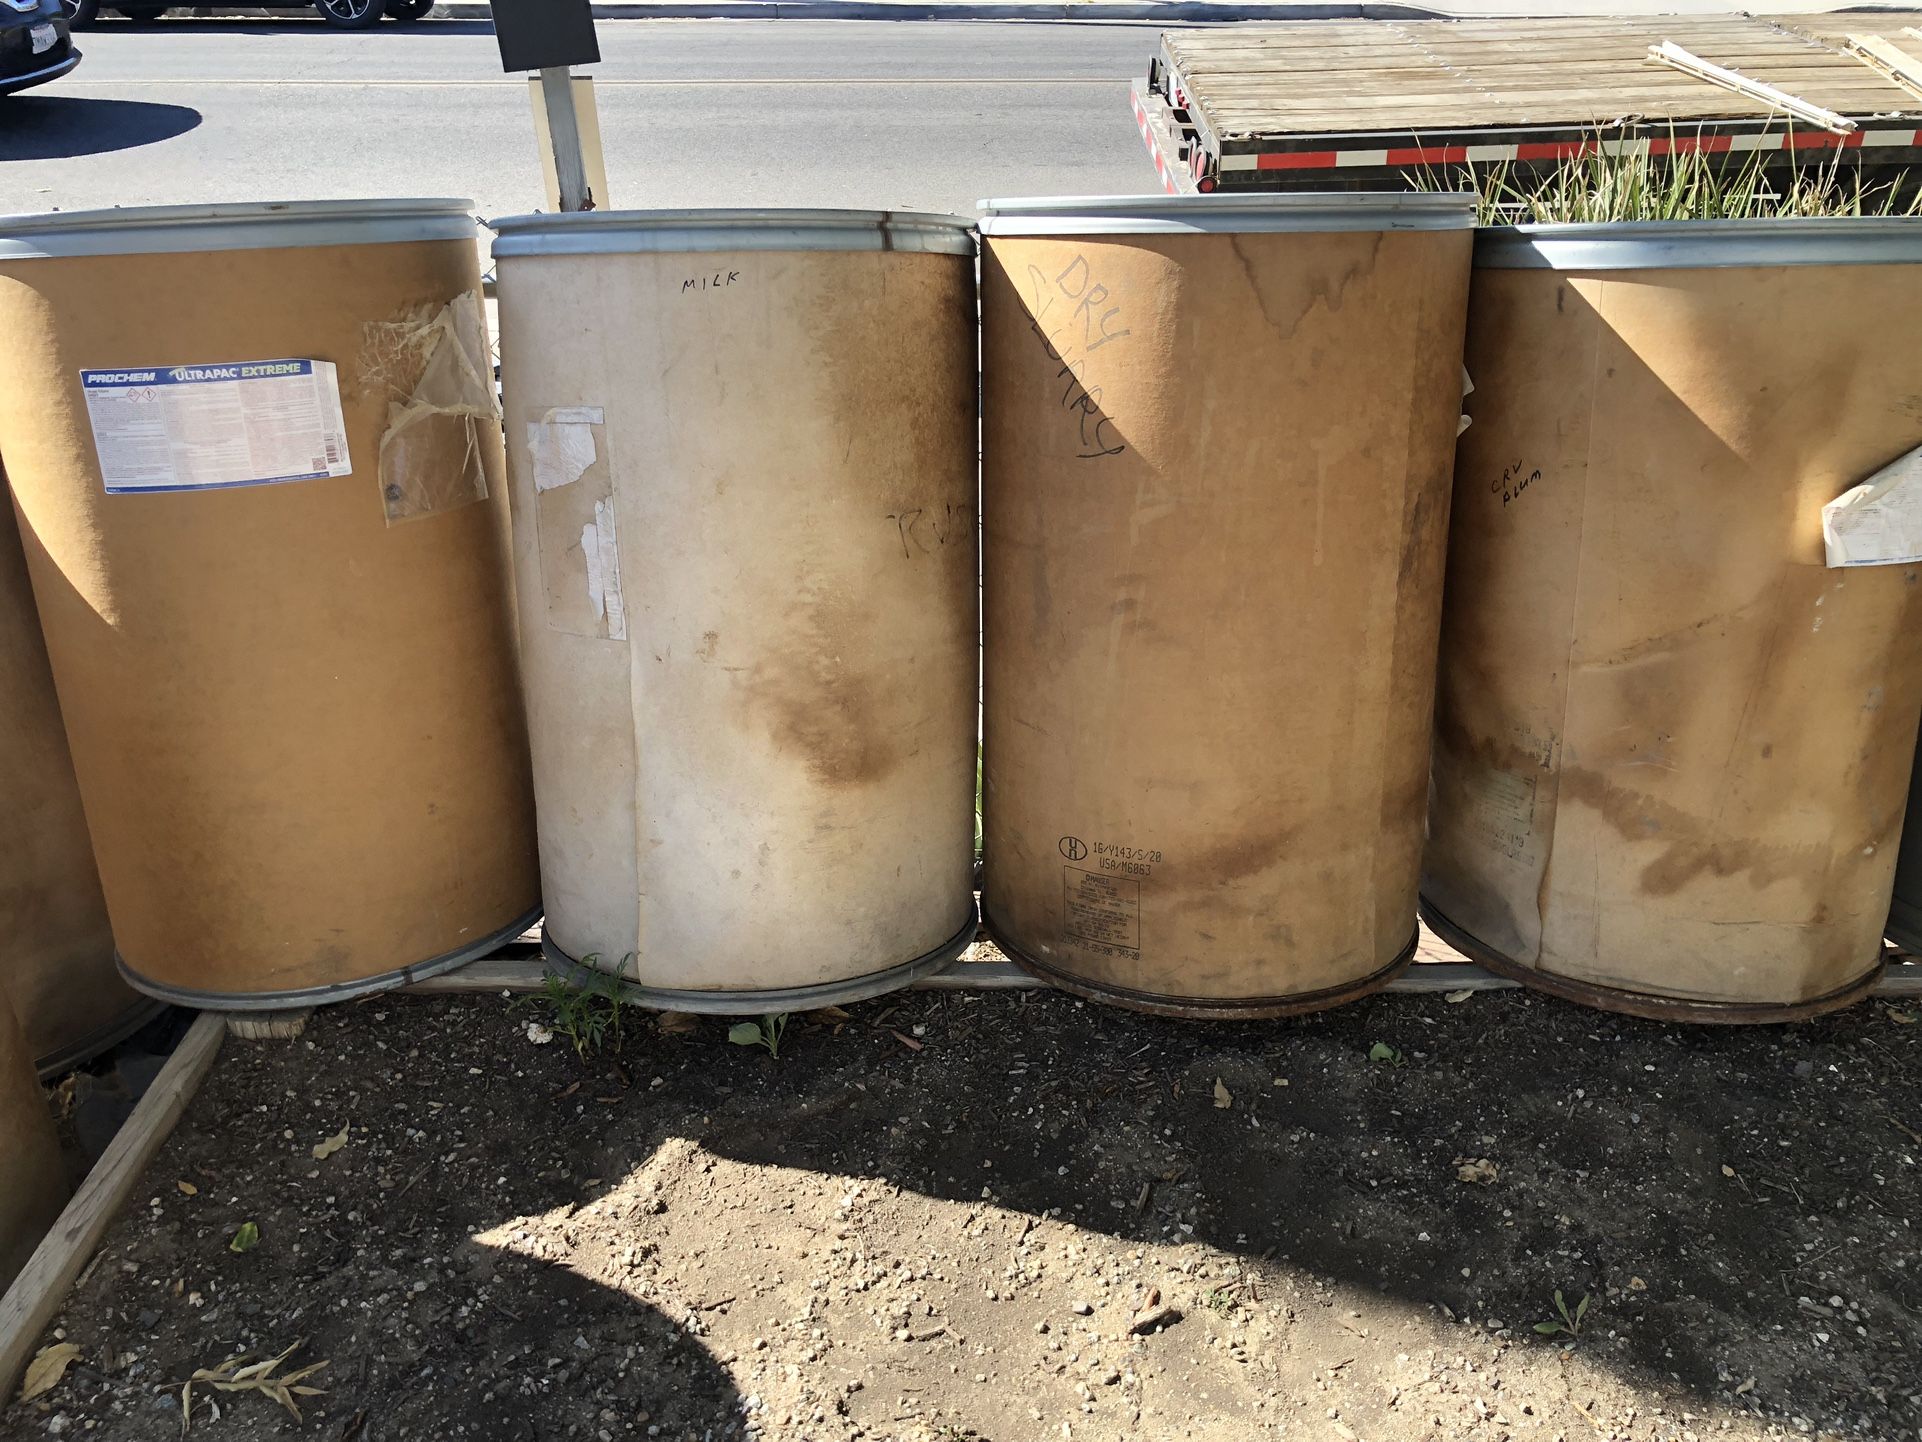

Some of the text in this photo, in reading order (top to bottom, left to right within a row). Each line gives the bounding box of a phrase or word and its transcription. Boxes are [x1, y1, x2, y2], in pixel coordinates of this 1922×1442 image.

[681, 271, 740, 295] MILK
[1056, 255, 1131, 352] DRY
[87, 372, 156, 384] PROCHEM
[173, 363, 301, 381] ULTRAPAC EXTREME
[1491, 459, 1522, 494] CRV
[1099, 857, 1152, 876] USA/M6063
